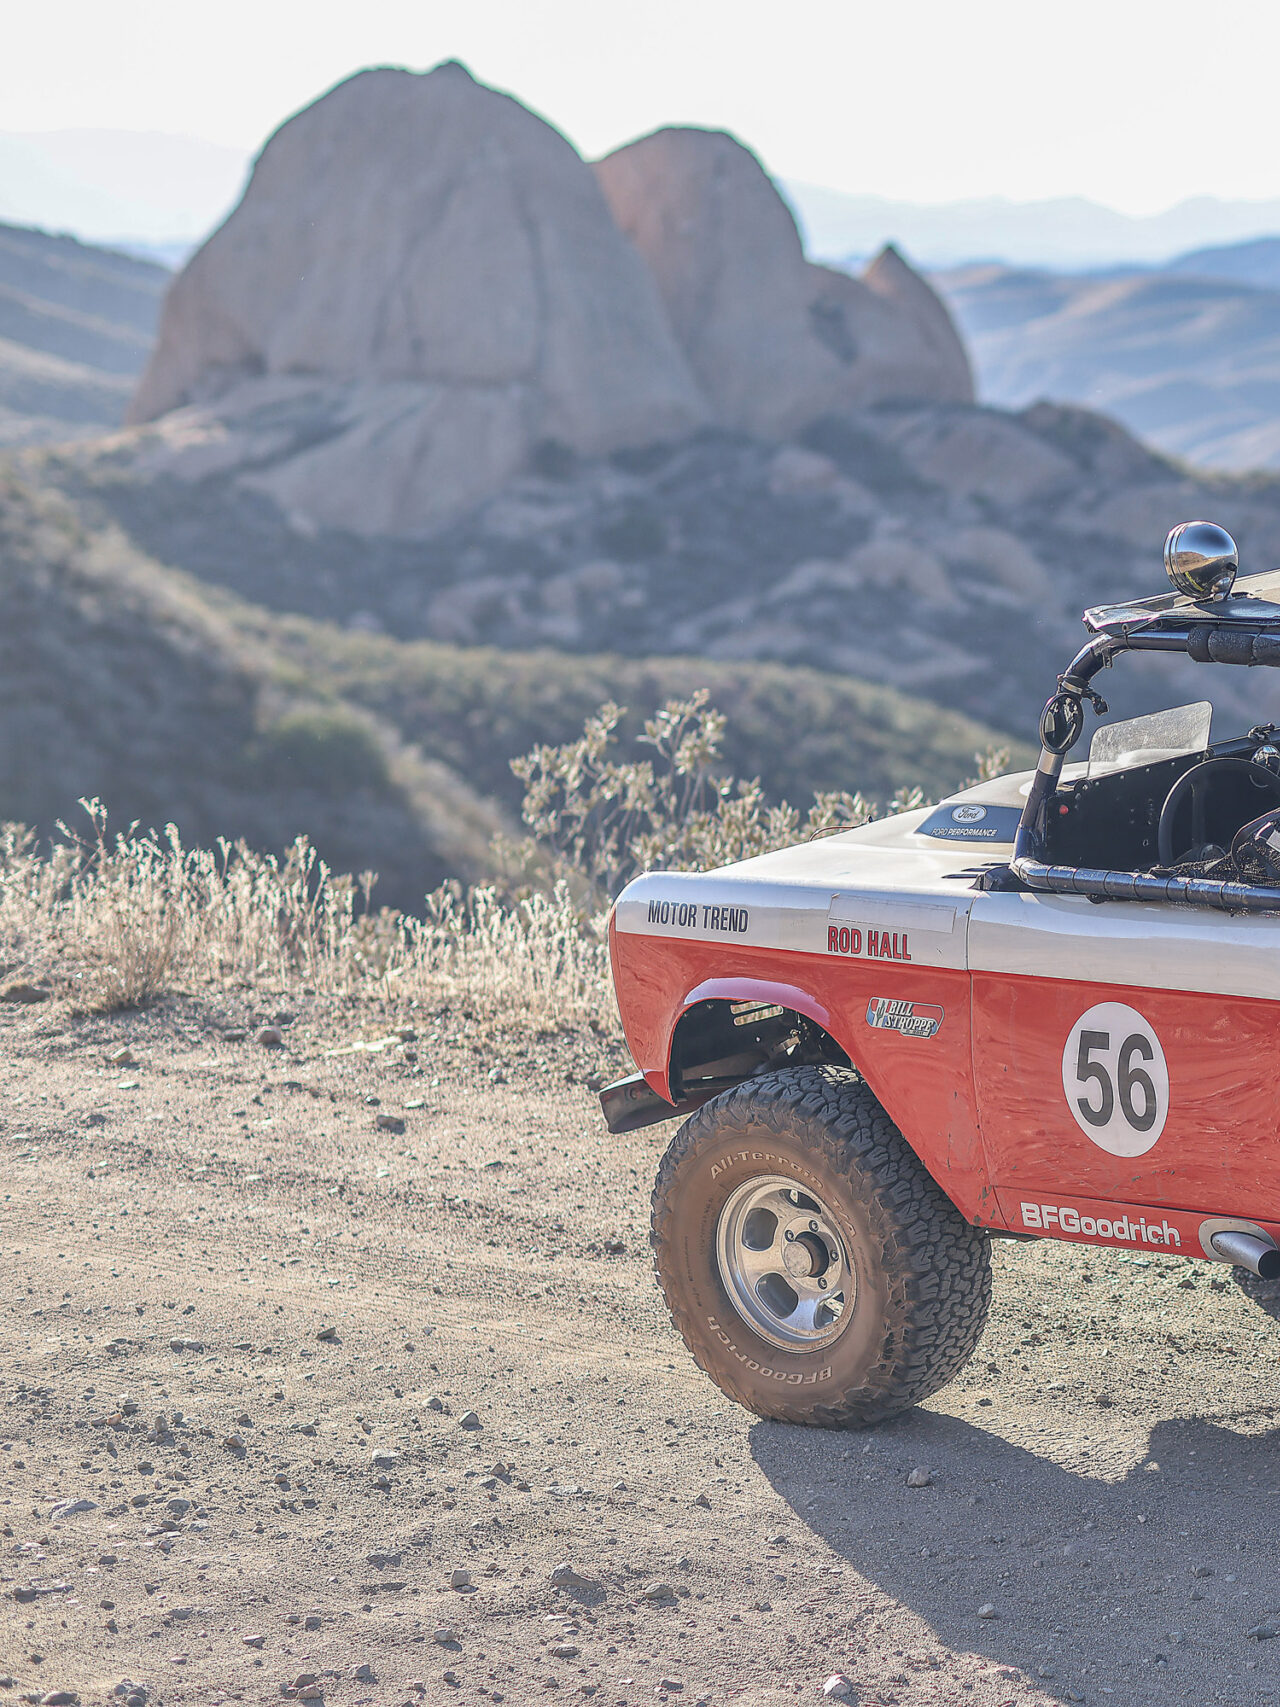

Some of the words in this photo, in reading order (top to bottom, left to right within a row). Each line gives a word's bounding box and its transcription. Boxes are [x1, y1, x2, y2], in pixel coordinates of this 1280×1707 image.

[931, 828, 949, 836] FORD
[948, 828, 998, 837] PERFORMANCE
[647, 899, 698, 928] MOTOR
[702, 905, 749, 933] TREND
[827, 925, 863, 955] ROD
[867, 929, 912, 961] HALL
[884, 1014, 935, 1032] STROPPE
[889, 1001, 914, 1017] BILL
[1076, 1029, 1158, 1133] 56
[710, 1150, 824, 1189] All-Terrain
[1020, 1202, 1182, 1247] BFGoodrich
[706, 1315, 833, 1386] BFGoodrich
